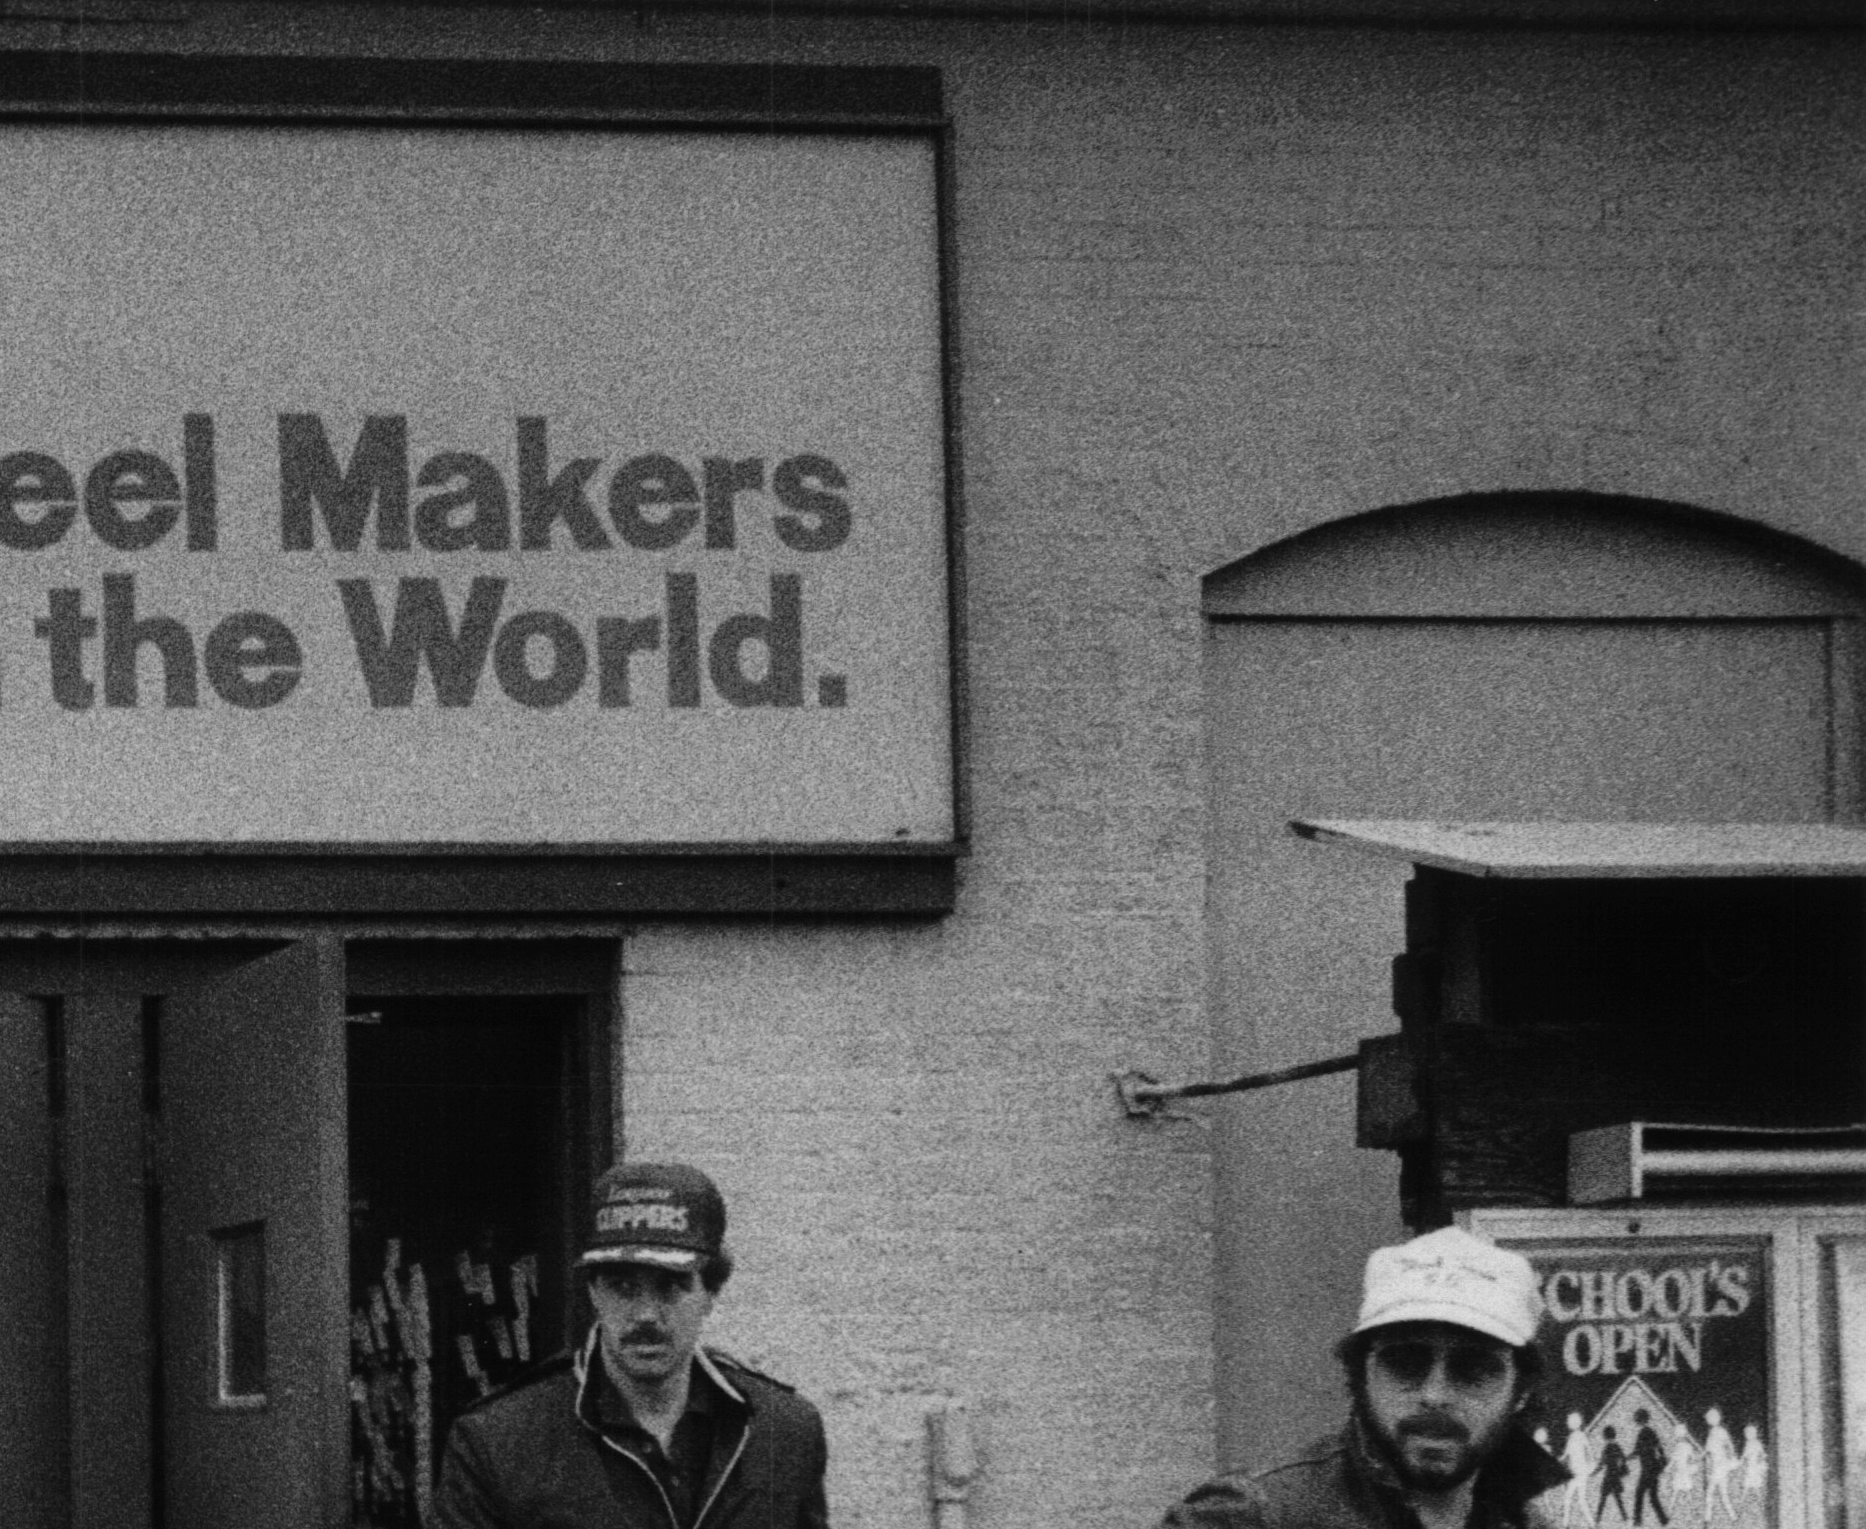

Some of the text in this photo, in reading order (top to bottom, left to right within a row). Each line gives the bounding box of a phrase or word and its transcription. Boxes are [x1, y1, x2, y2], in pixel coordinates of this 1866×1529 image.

[279, 413, 852, 552] Makers
[35, 572, 302, 710] the
[338, 572, 847, 709] World.
[596, 1203, 689, 1232] CLIPPERS
[1537, 1260, 1751, 1322] CHOOL'S
[1563, 1322, 1702, 1375] OPEN
